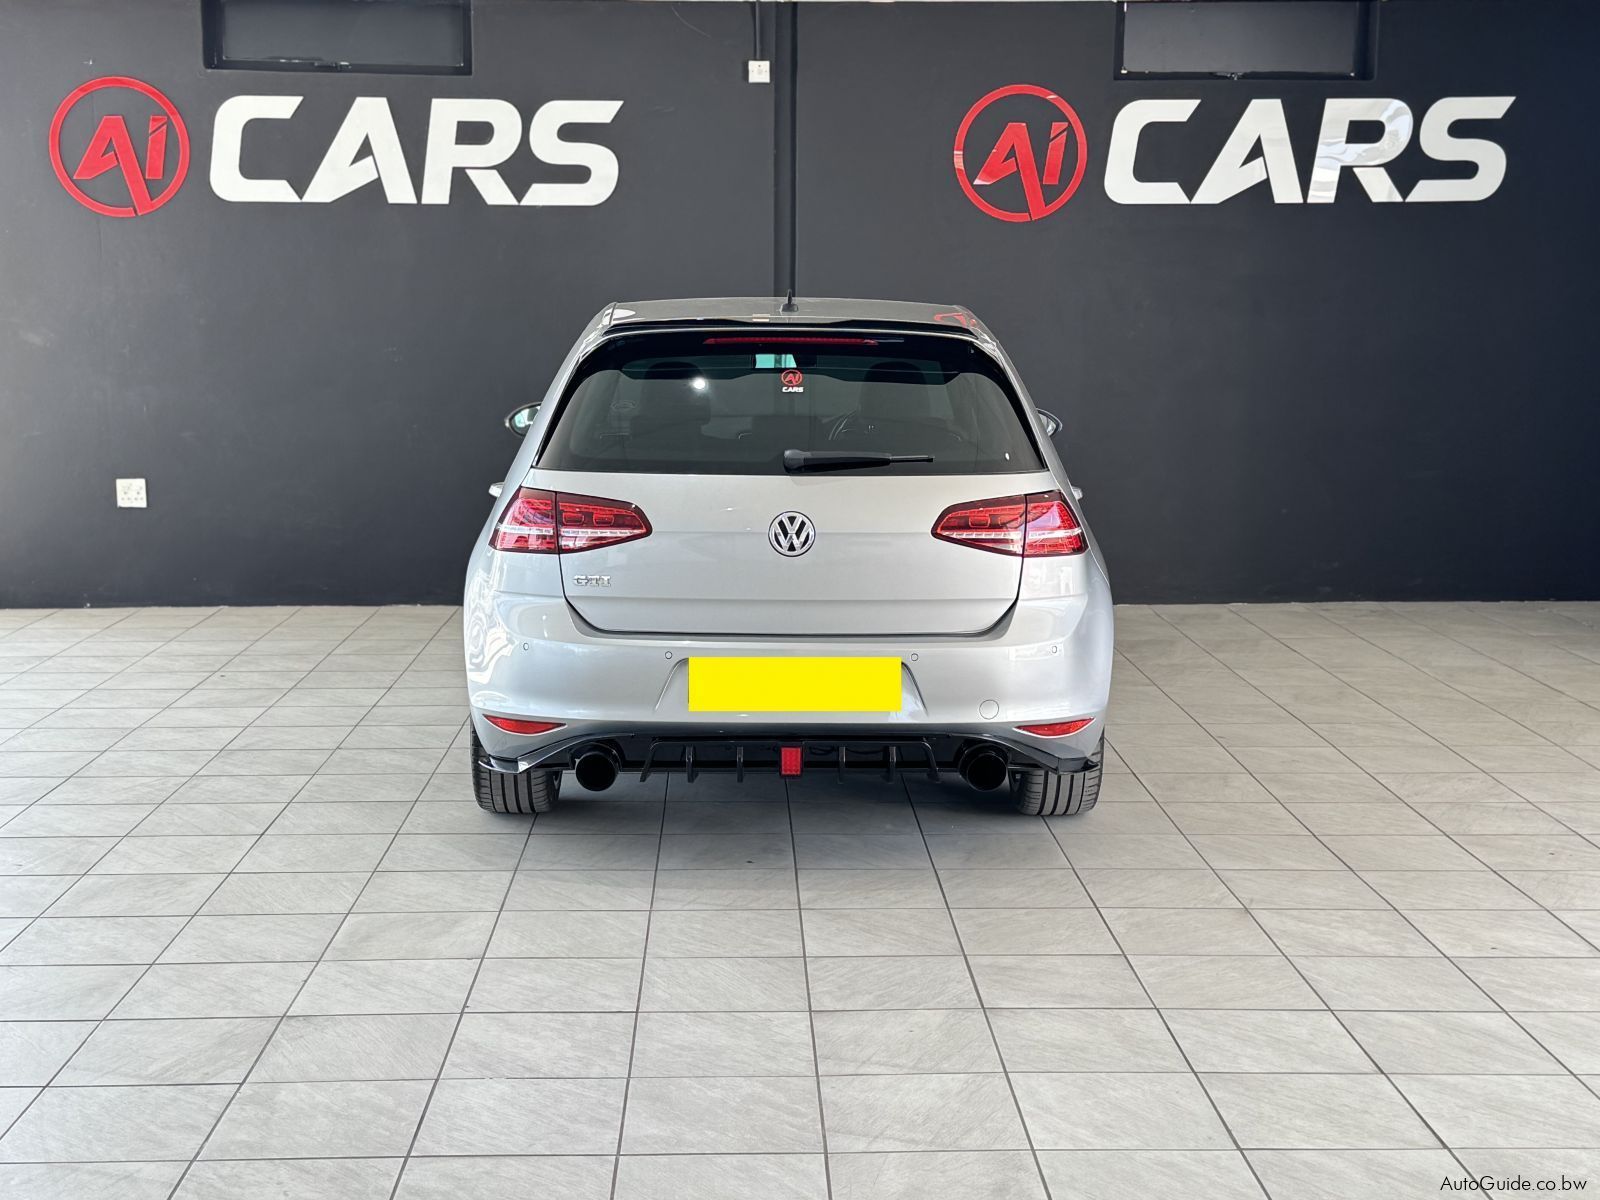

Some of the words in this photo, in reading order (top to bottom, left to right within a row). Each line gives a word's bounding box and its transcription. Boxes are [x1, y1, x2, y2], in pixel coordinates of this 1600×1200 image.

[209, 95, 624, 206] CARS
[1104, 95, 1516, 205] CARS
[573, 575, 611, 587] GTI
